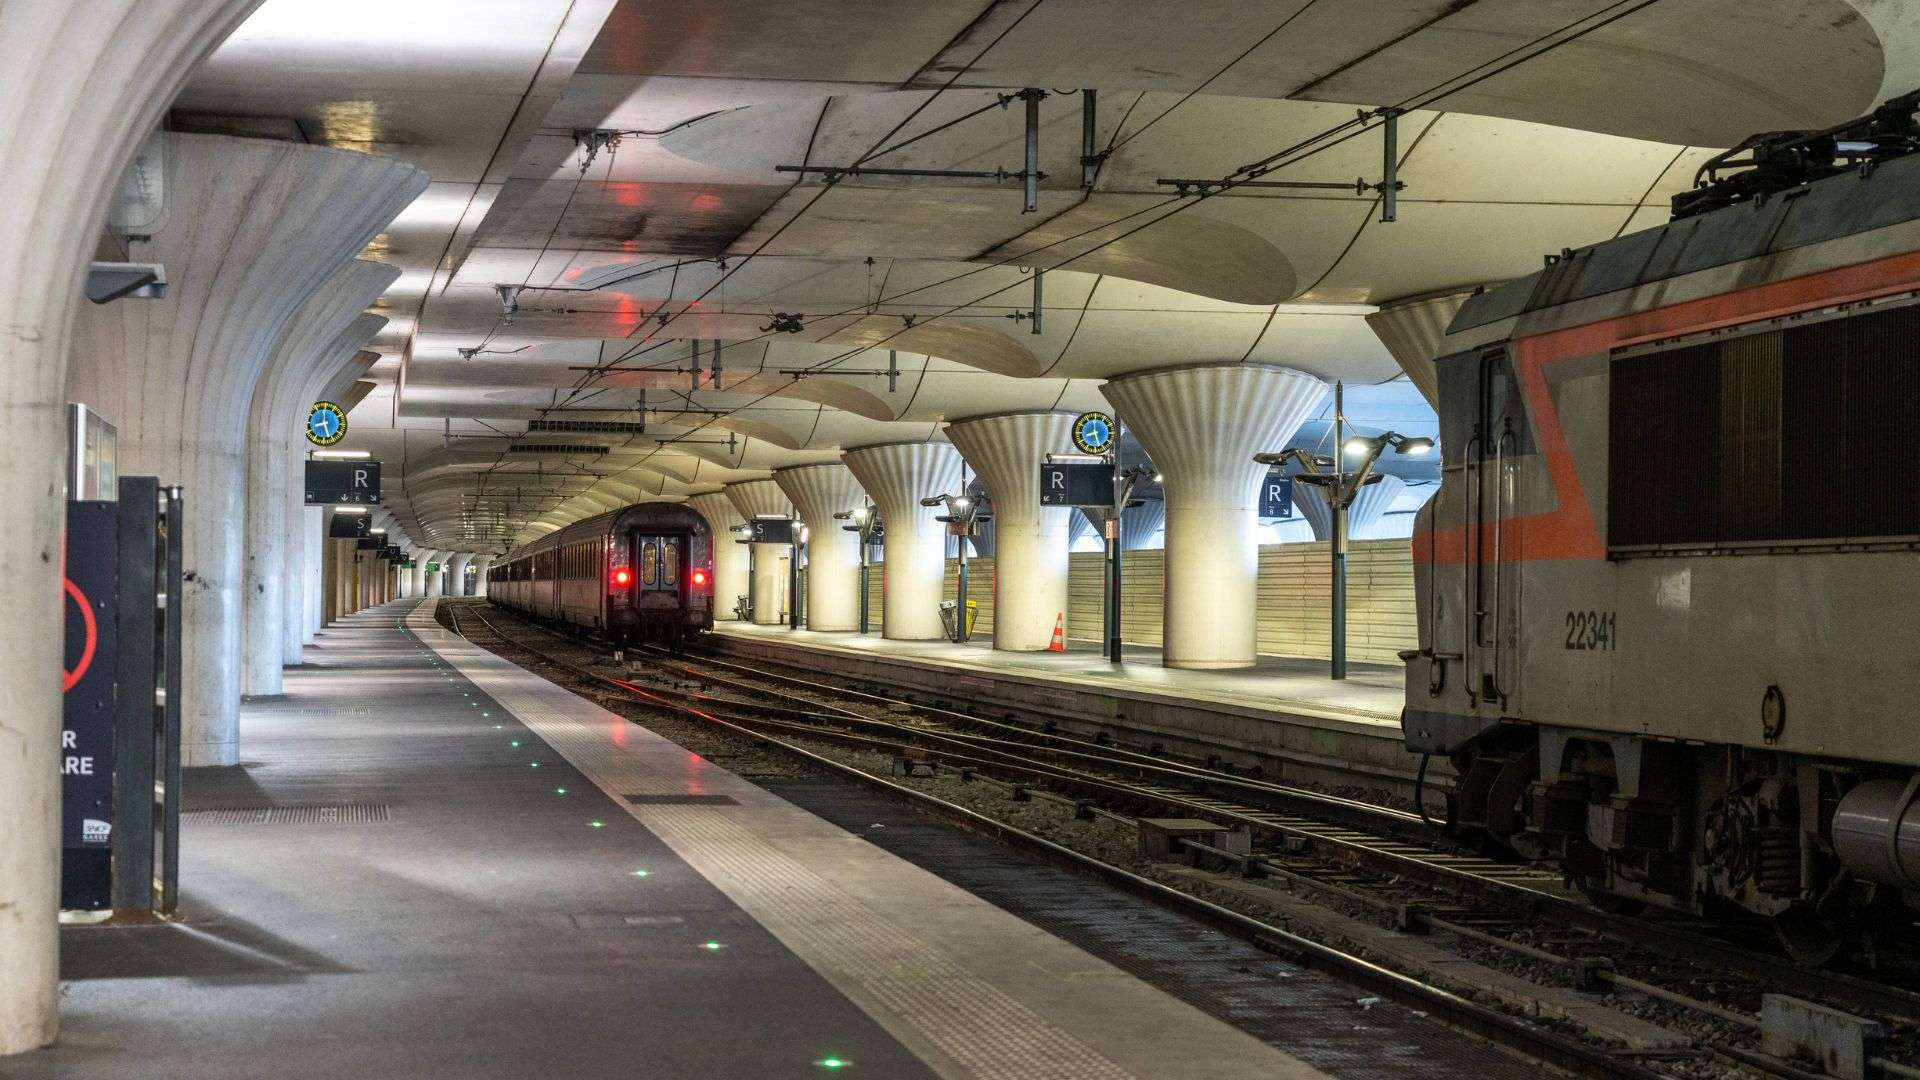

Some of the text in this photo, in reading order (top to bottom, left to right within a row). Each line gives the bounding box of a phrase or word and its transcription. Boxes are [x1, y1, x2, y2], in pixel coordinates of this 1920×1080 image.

[354, 469, 368, 488] R
[1052, 472, 1064, 488] R
[1269, 484, 1282, 502] R
[358, 518, 364, 528] S
[756, 524, 764, 534] S
[1565, 611, 1616, 651] 22341
